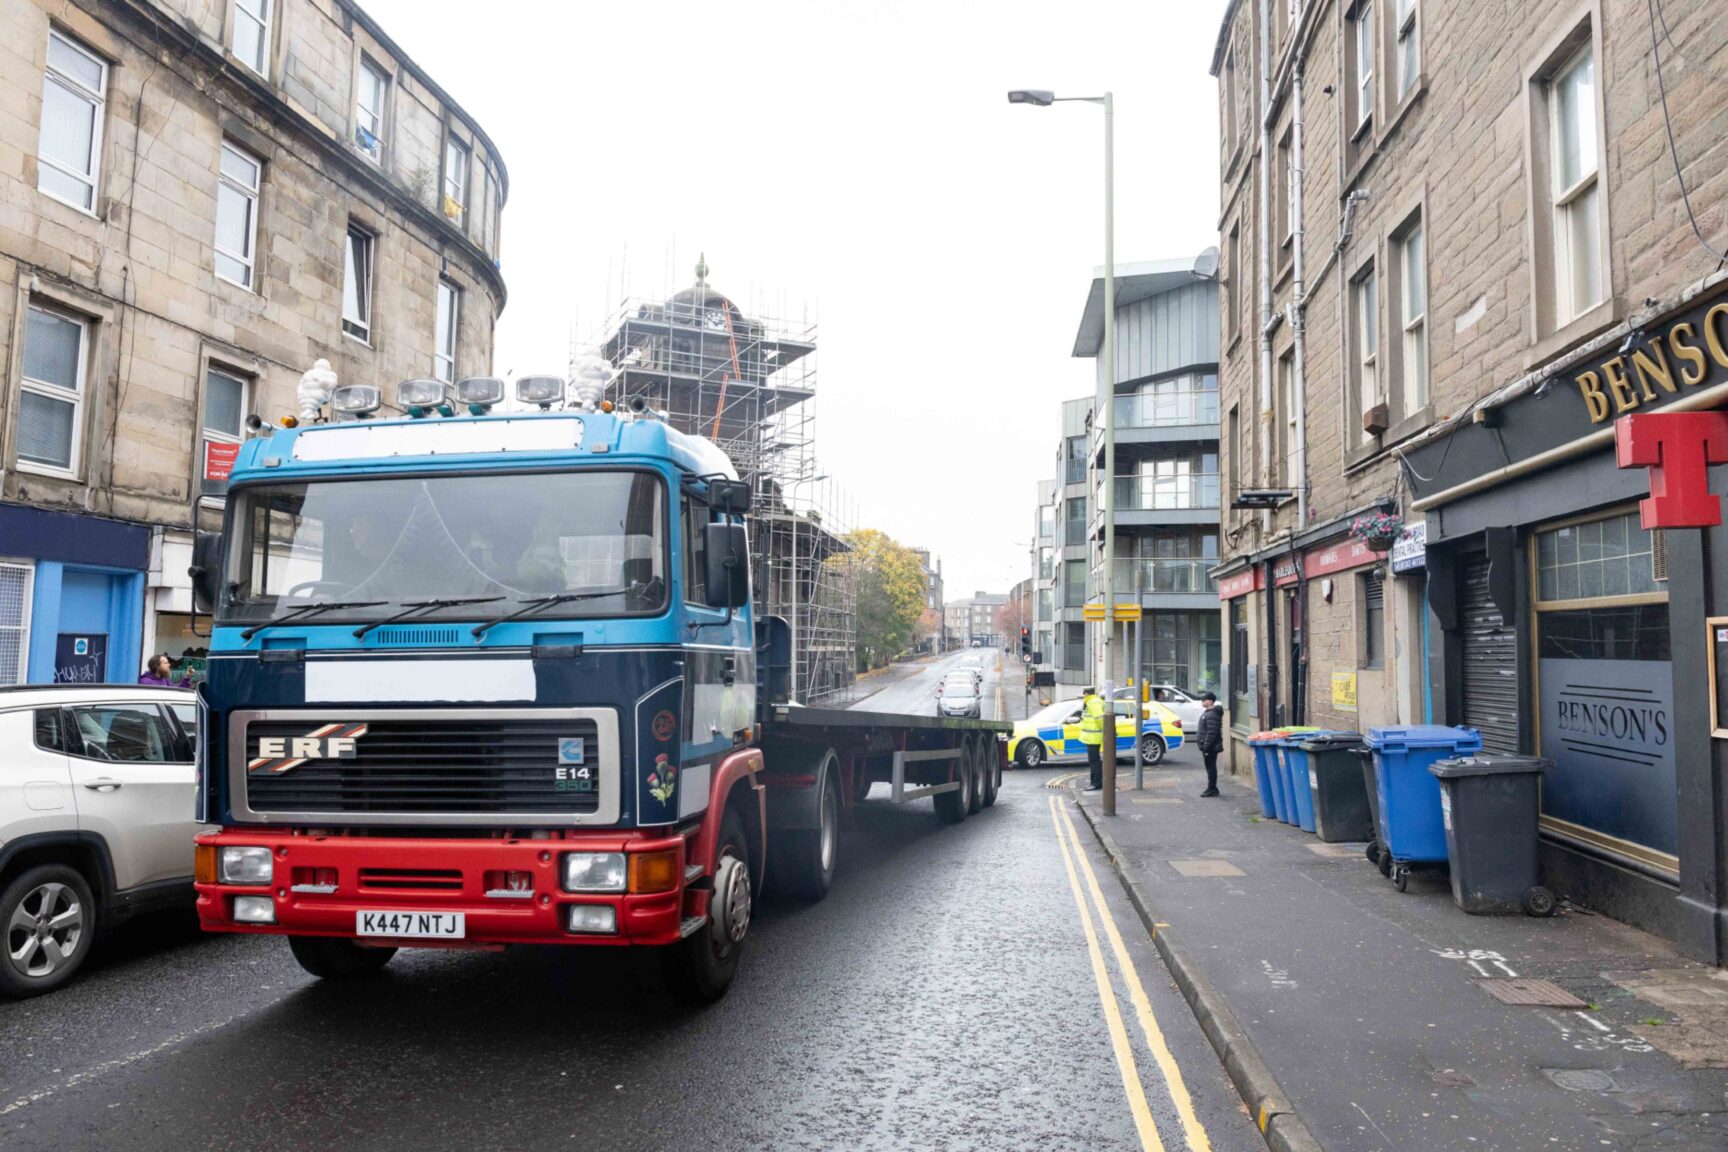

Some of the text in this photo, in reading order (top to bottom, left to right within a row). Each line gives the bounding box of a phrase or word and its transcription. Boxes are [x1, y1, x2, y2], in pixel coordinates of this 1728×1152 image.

[1557, 700, 1667, 746] BENSON'S
[259, 737, 356, 758] ERF
[554, 780, 592, 791] 350
[364, 913, 457, 934] K447 NTJ
